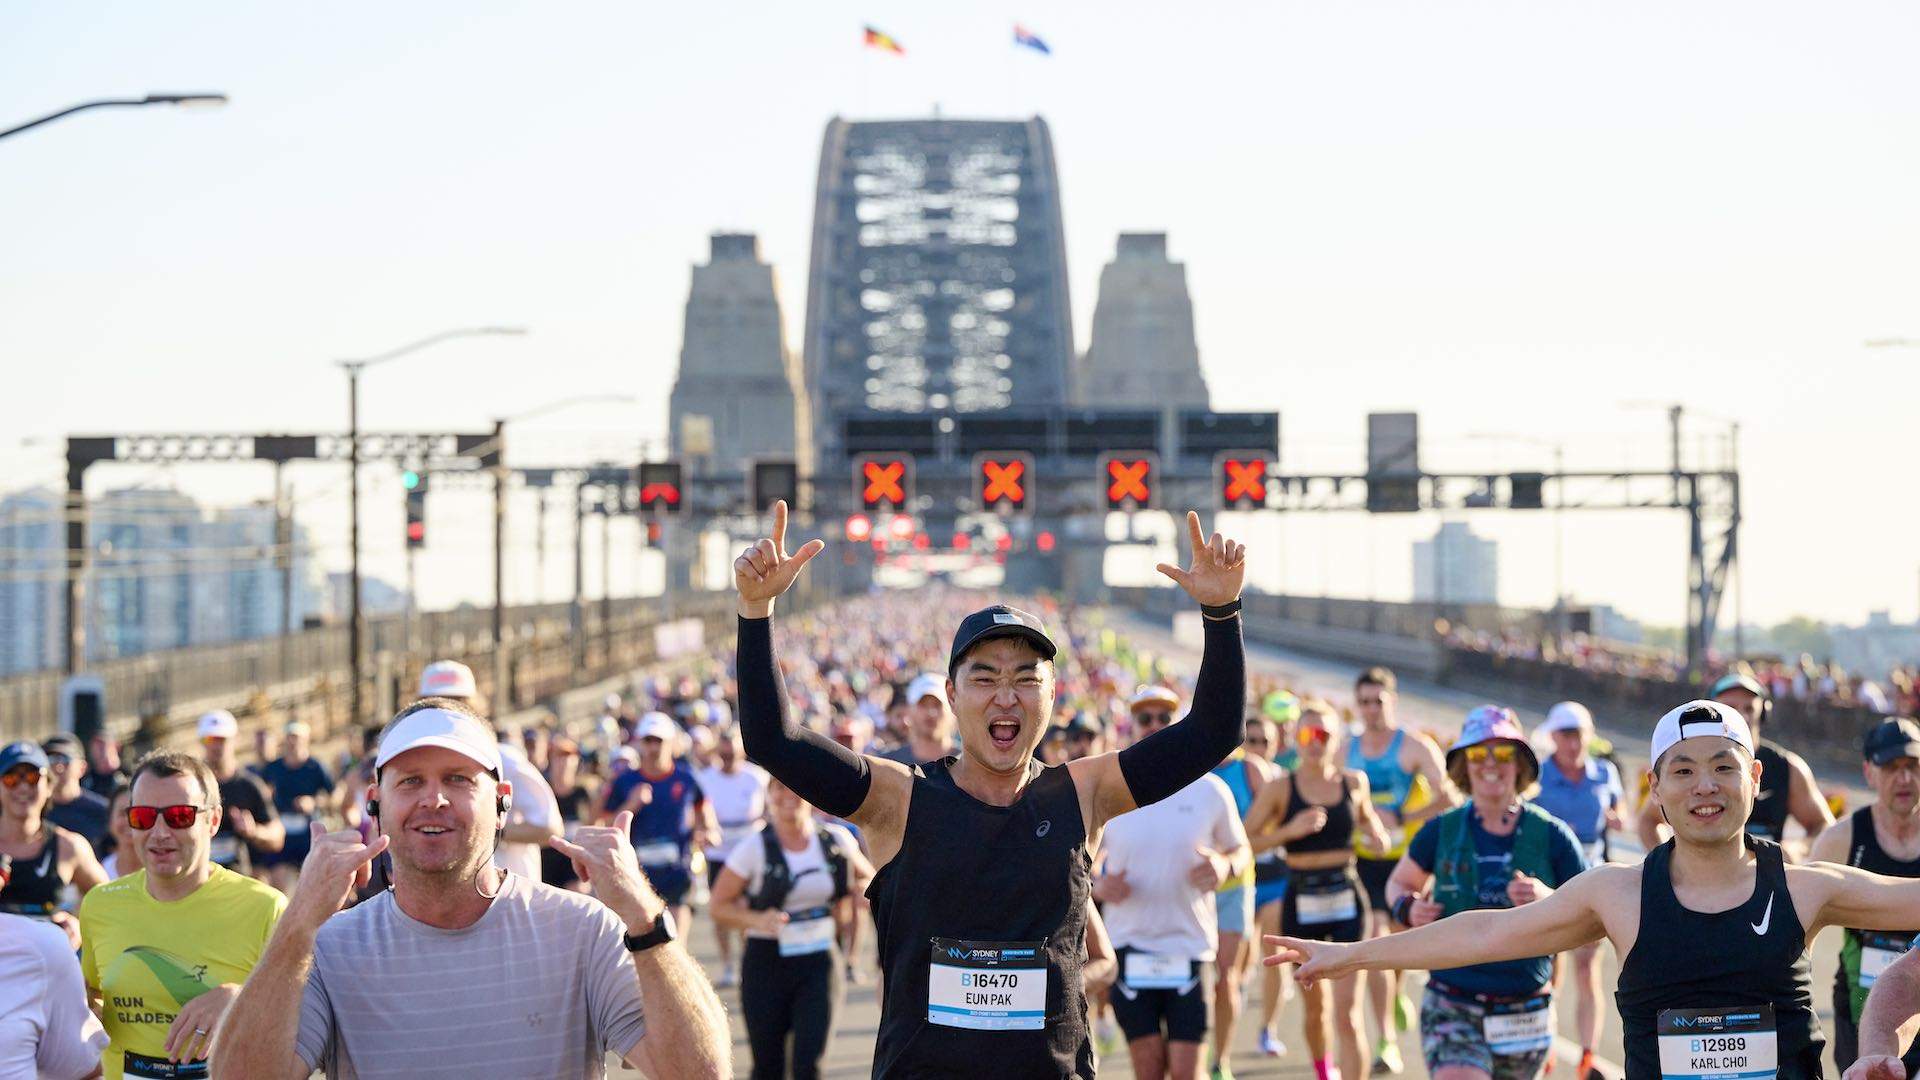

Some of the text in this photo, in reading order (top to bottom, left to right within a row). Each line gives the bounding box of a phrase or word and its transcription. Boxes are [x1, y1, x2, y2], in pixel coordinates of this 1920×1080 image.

[972, 950, 999, 958] SYDNEY
[961, 973, 1018, 988] B16470
[113, 996, 144, 1008] RUN
[966, 993, 1012, 1006] EUN PAK
[118, 1012, 178, 1024] GLADES
[1697, 1016, 1723, 1024] SYDNEY
[1691, 1037, 1746, 1052] B12989
[1691, 1056, 1748, 1069] KARL CHOI
